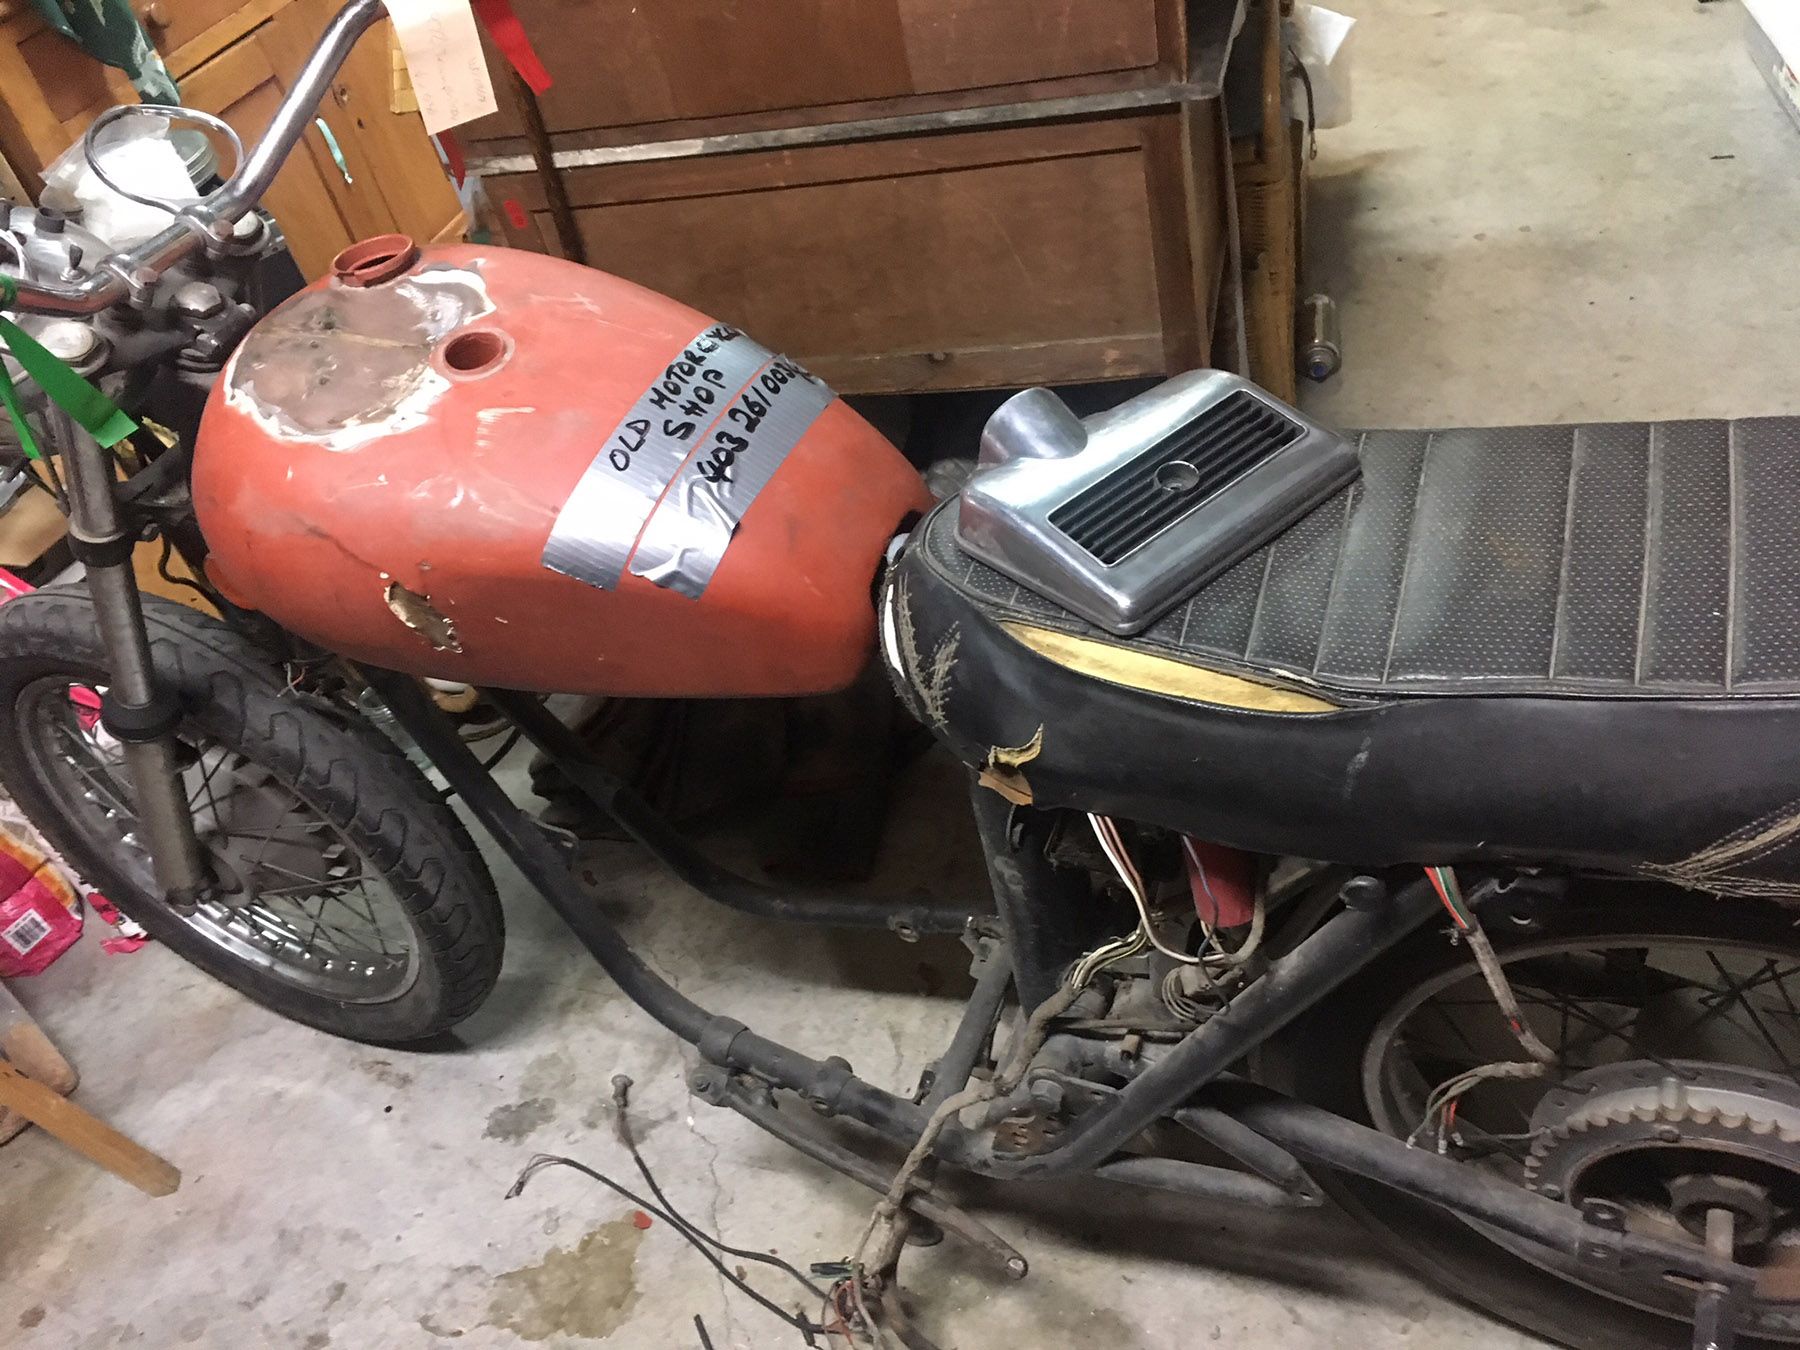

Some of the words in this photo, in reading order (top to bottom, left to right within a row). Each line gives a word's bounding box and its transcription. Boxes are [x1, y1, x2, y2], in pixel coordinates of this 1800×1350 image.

[663, 368, 727, 441] SHOP
[609, 419, 651, 472] OLD
[696, 430, 750, 484] 403
